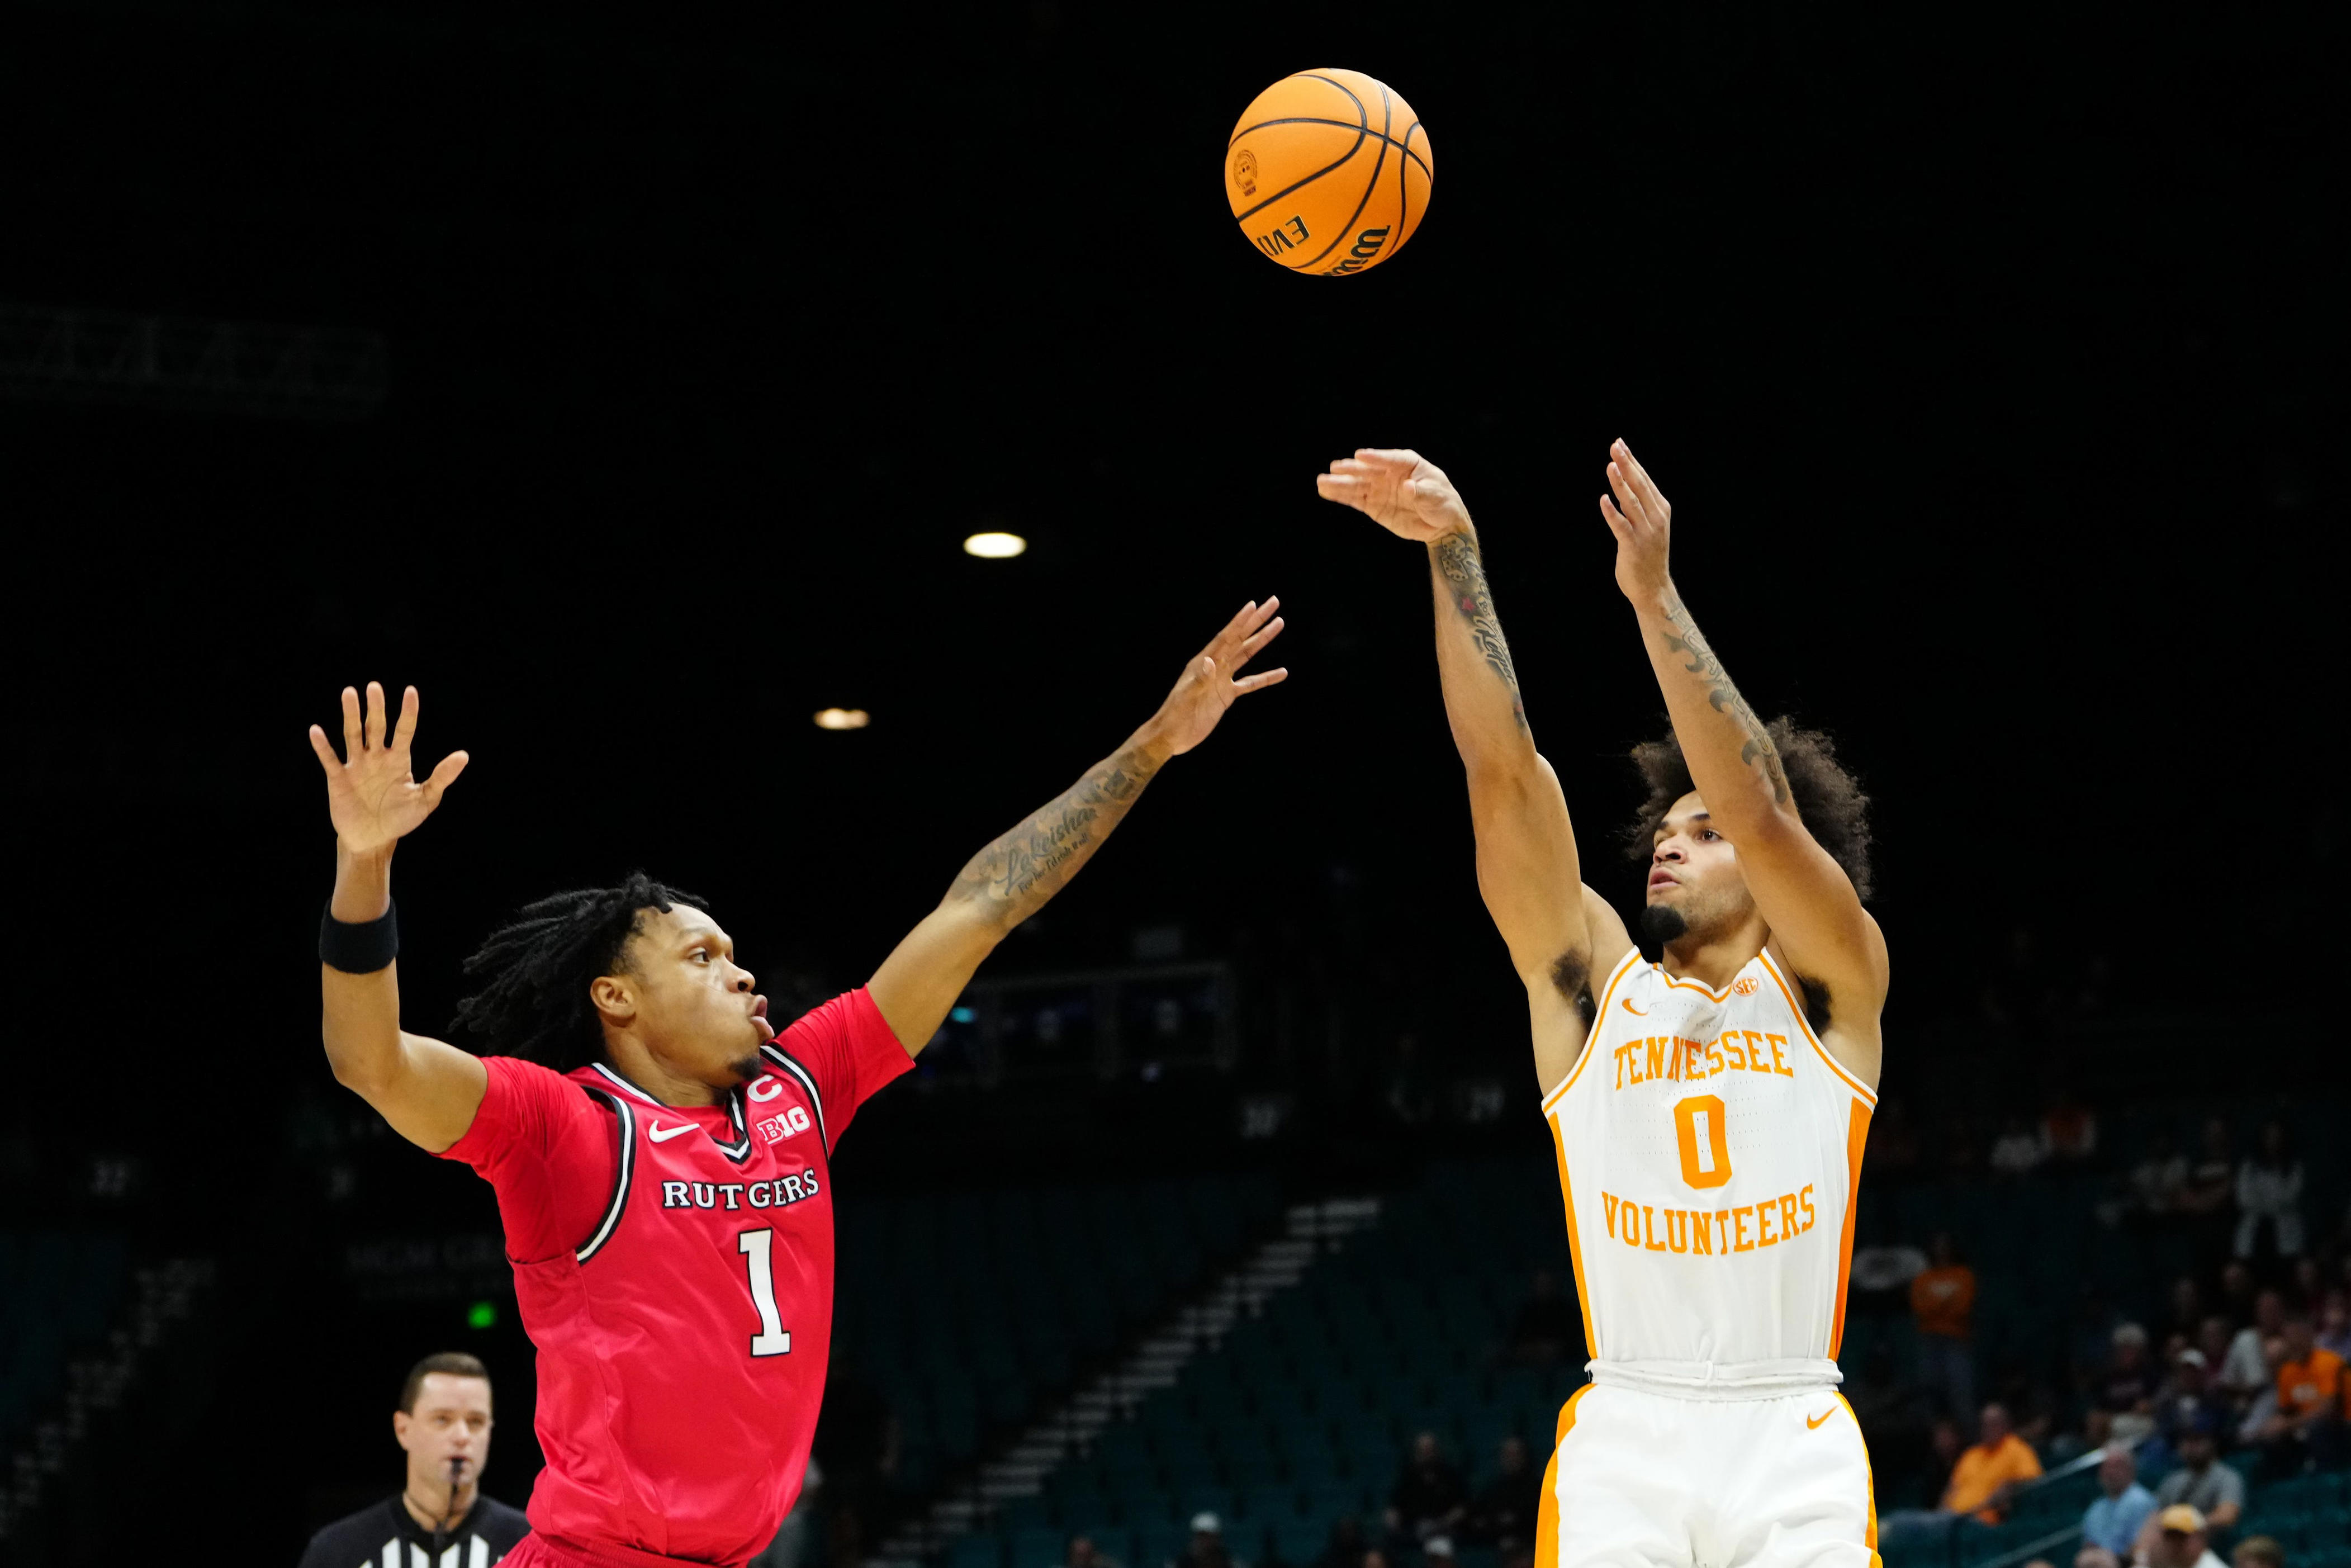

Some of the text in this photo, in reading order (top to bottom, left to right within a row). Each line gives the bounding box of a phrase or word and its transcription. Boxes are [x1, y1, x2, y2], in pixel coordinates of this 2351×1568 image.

[1734, 978, 1757, 994] SEC
[747, 1074, 783, 1103] C
[1614, 1029, 1794, 1091] TENNESSEE
[1673, 1094, 1732, 1190] 0
[662, 1168, 819, 1210] RUTGERS
[1601, 1182, 1815, 1256] VOLUNTEERS
[738, 1227, 790, 1357] 1
